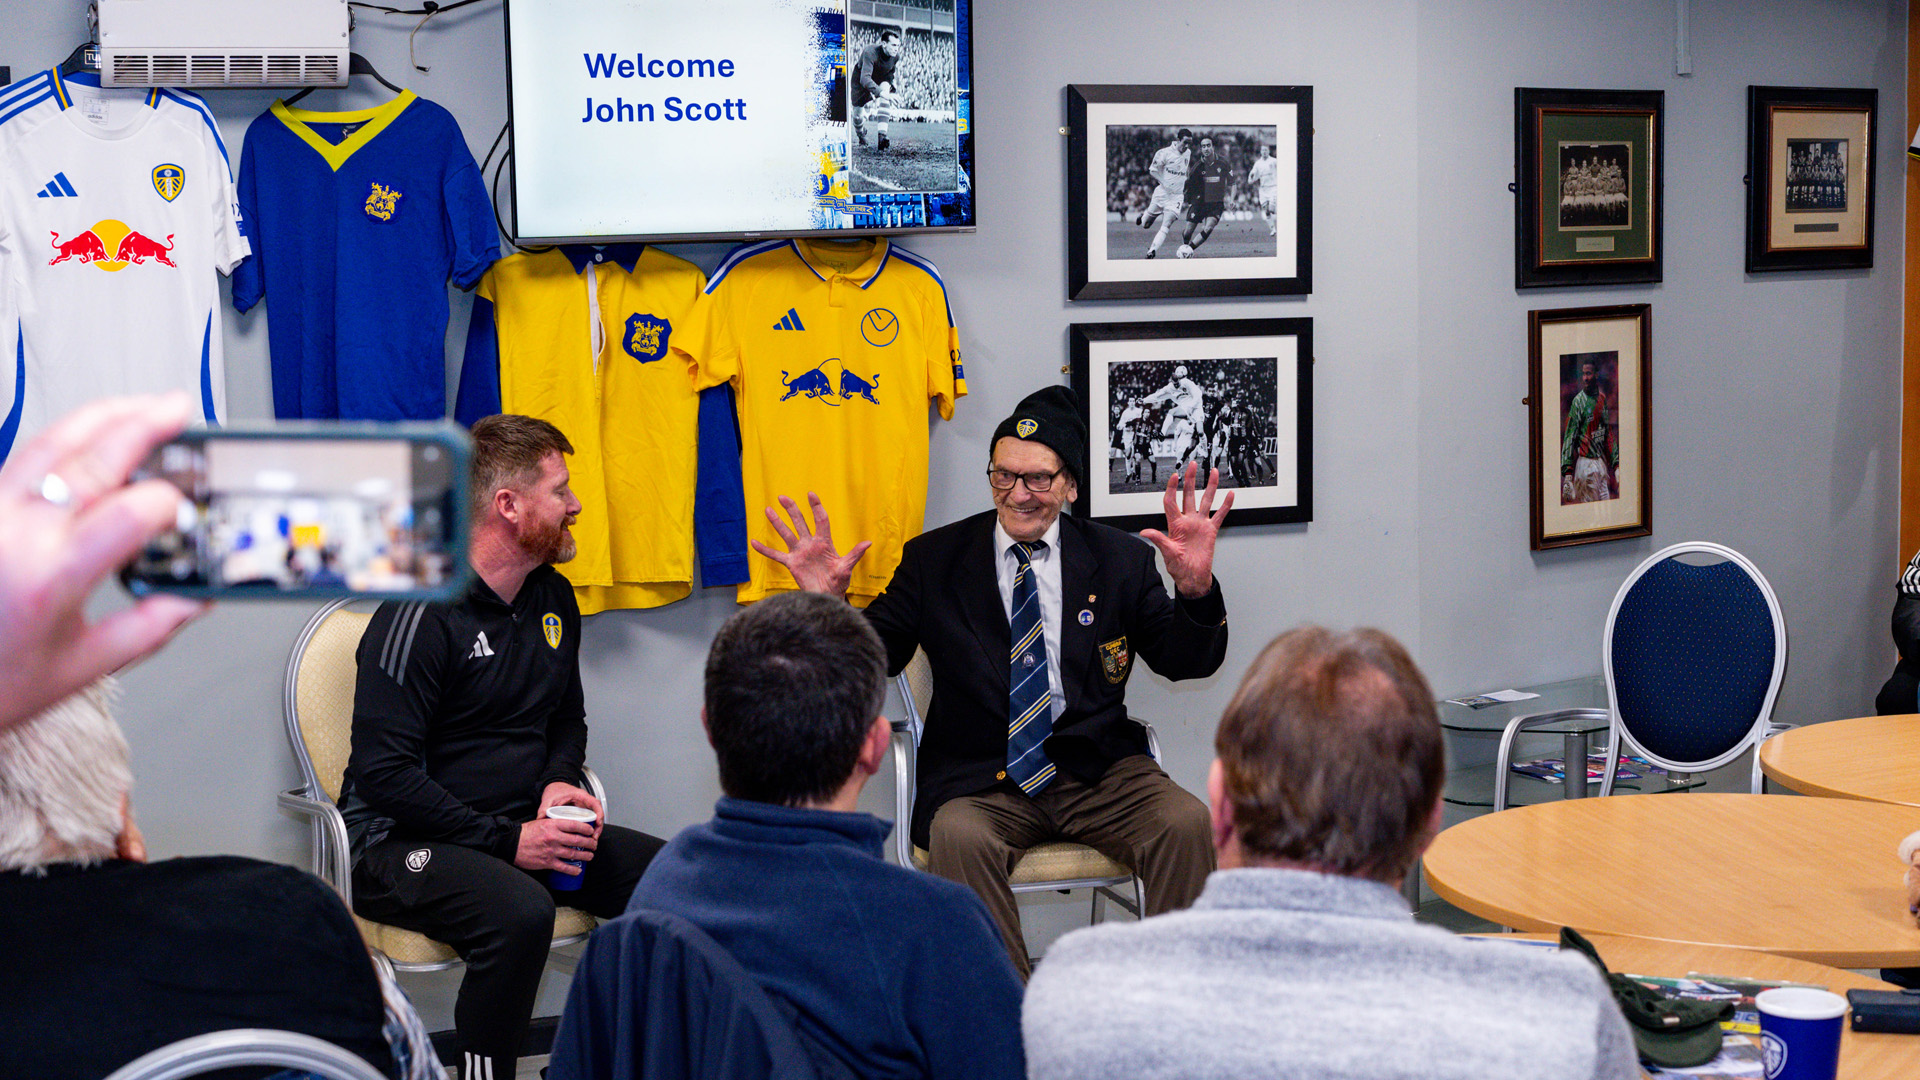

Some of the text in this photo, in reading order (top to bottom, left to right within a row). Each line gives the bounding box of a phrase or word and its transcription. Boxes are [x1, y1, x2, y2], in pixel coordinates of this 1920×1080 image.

[583, 53, 735, 79] Welcome
[582, 96, 747, 123] John Scott
